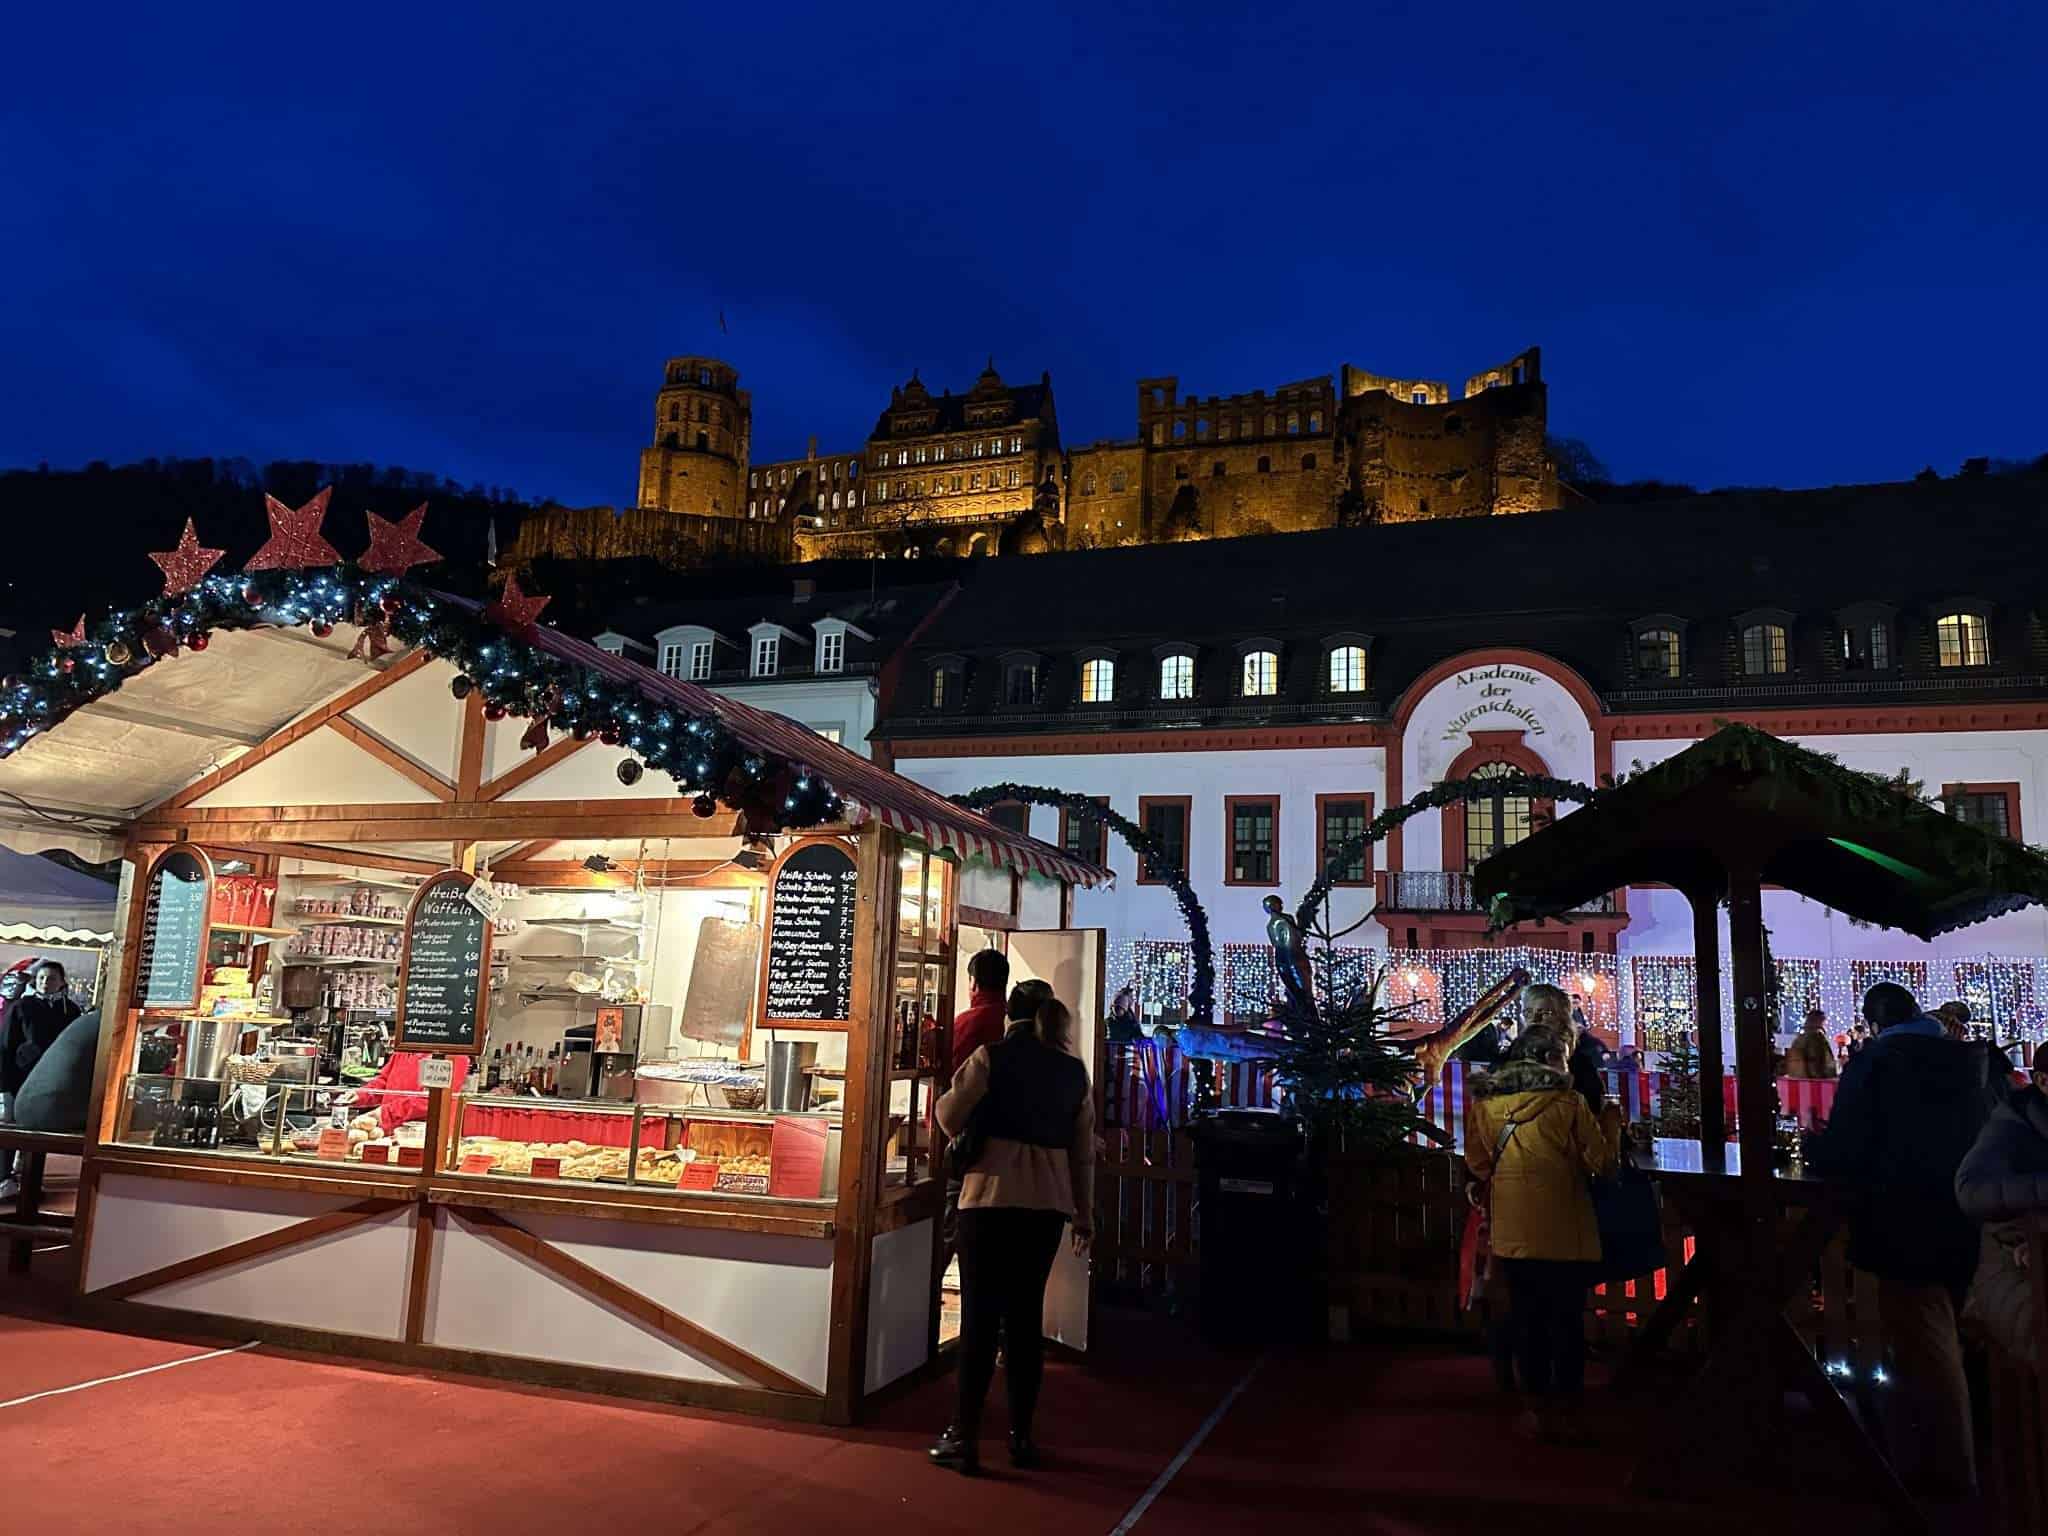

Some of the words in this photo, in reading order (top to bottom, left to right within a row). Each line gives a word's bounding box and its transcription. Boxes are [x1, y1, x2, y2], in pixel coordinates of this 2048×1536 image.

[1456, 665, 1541, 689] Akademie
[1480, 683, 1512, 698] der
[780, 870, 803, 880] Heiße
[803, 871, 832, 880] Schoko
[840, 872, 857, 881] 4,50
[430, 886, 465, 899] Heiße
[777, 882, 802, 890] Schoko
[803, 882, 835, 894] Baileys
[424, 903, 472, 916] Waffeln
[773, 928, 820, 938] Lumumba
[771, 957, 787, 966] Tee
[770, 969, 788, 979] Tee
[805, 969, 827, 979] Rum
